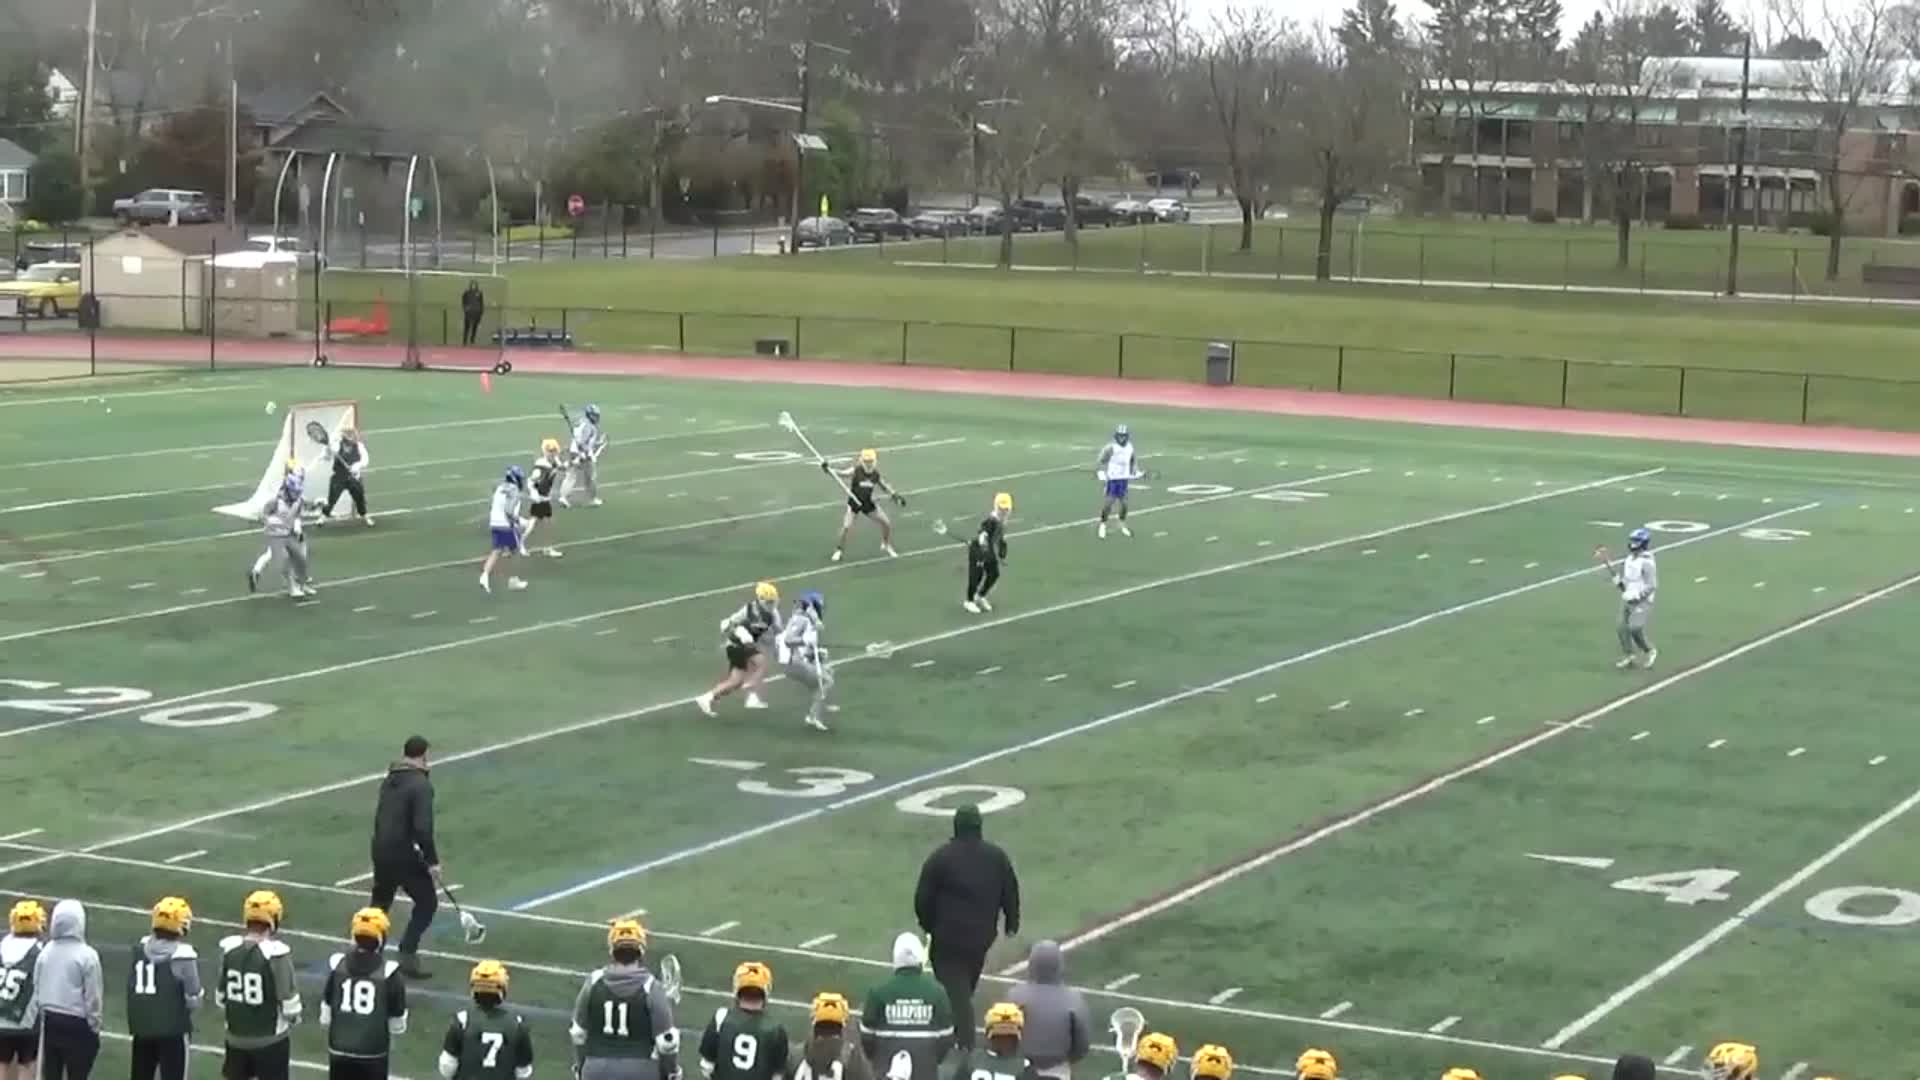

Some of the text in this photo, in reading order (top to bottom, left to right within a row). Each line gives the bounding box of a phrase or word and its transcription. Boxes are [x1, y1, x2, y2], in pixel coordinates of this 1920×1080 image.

[134, 962, 156, 994] 11
[226, 970, 263, 1005] 28
[340, 980, 376, 1015] 18
[602, 1000, 629, 1036] 11
[481, 1032, 504, 1067] 7
[732, 1033, 758, 1070] 9
